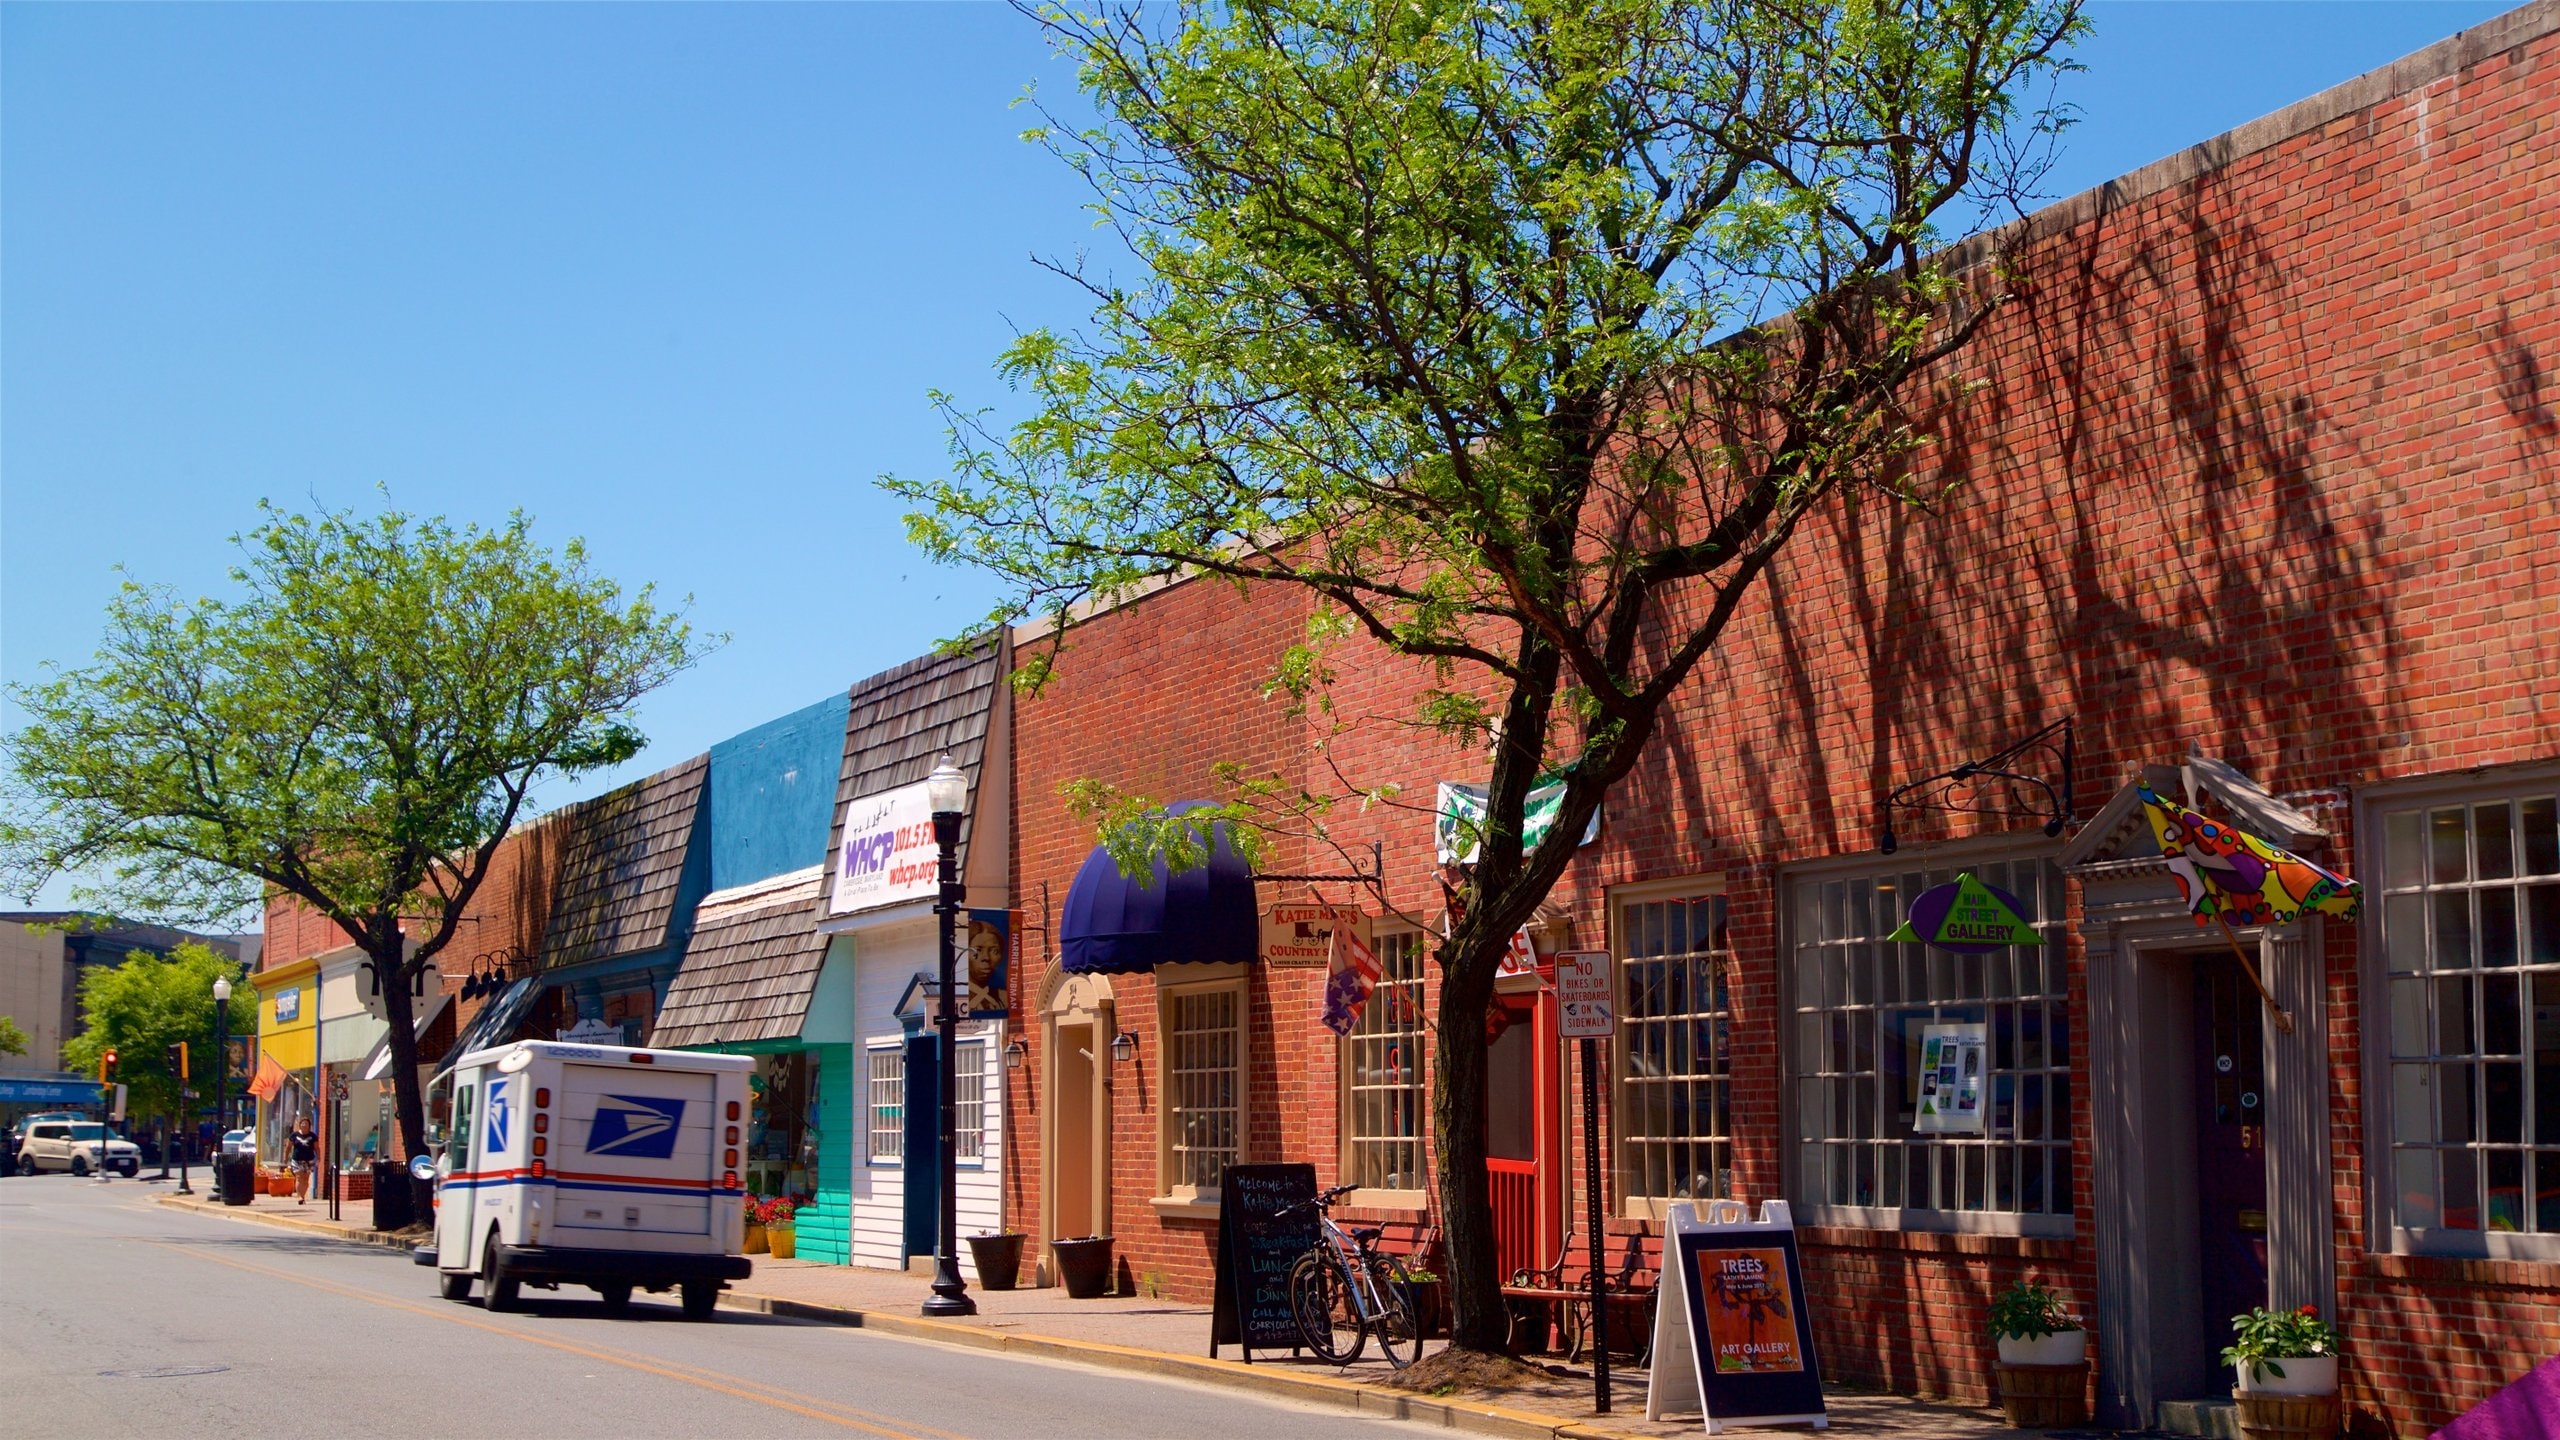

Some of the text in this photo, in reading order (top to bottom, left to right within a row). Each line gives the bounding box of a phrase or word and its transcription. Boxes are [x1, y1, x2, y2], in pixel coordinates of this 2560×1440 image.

[893, 824, 921, 853] 101.5
[845, 831, 895, 879] WHCP
[889, 858, 938, 889] whcp.org
[1963, 894, 1987, 906] MAIN
[1274, 909, 1359, 926] KATIE ME'S
[1956, 907, 2000, 923] STREET
[1946, 922, 2016, 941] GALLERY
[1011, 933, 1021, 972] HARRIET
[1270, 944, 1320, 957] COUNTRY
[1576, 962, 1592, 975] NO
[1008, 972, 1019, 1010] TUBMAN
[1566, 978, 1605, 989] BIKES OR
[1561, 991, 1611, 1003] SKATEBOARDS
[1581, 1005, 1593, 1015] ON
[1567, 1016, 1607, 1029] SIDEWALK
[1720, 1259, 1764, 1273] TREES
[1256, 1286, 1306, 1304] DINNR
[1720, 1342, 1791, 1355] ART GALLERY
